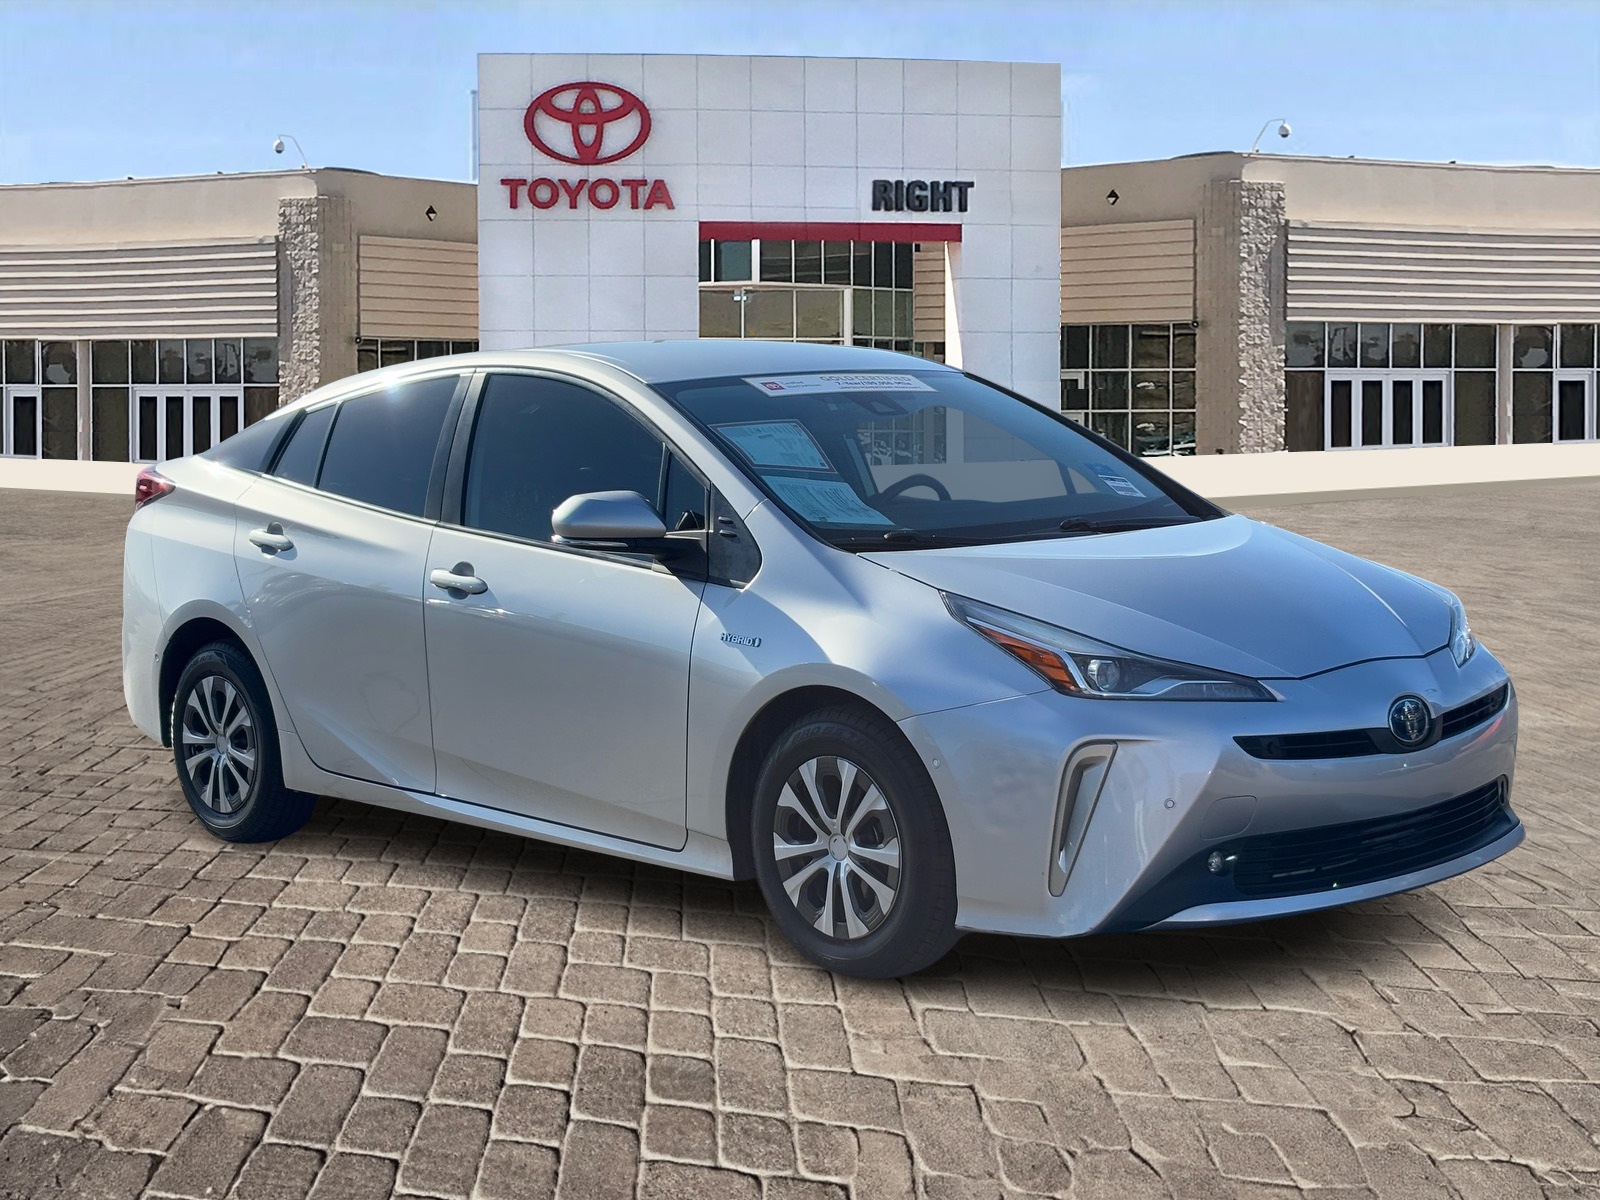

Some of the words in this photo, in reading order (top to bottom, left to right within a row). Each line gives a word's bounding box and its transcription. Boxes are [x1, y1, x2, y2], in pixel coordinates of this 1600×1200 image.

[501, 178, 675, 211] TOYOTA
[871, 179, 975, 213] RIGHT
[720, 632, 753, 647] HYBRID
